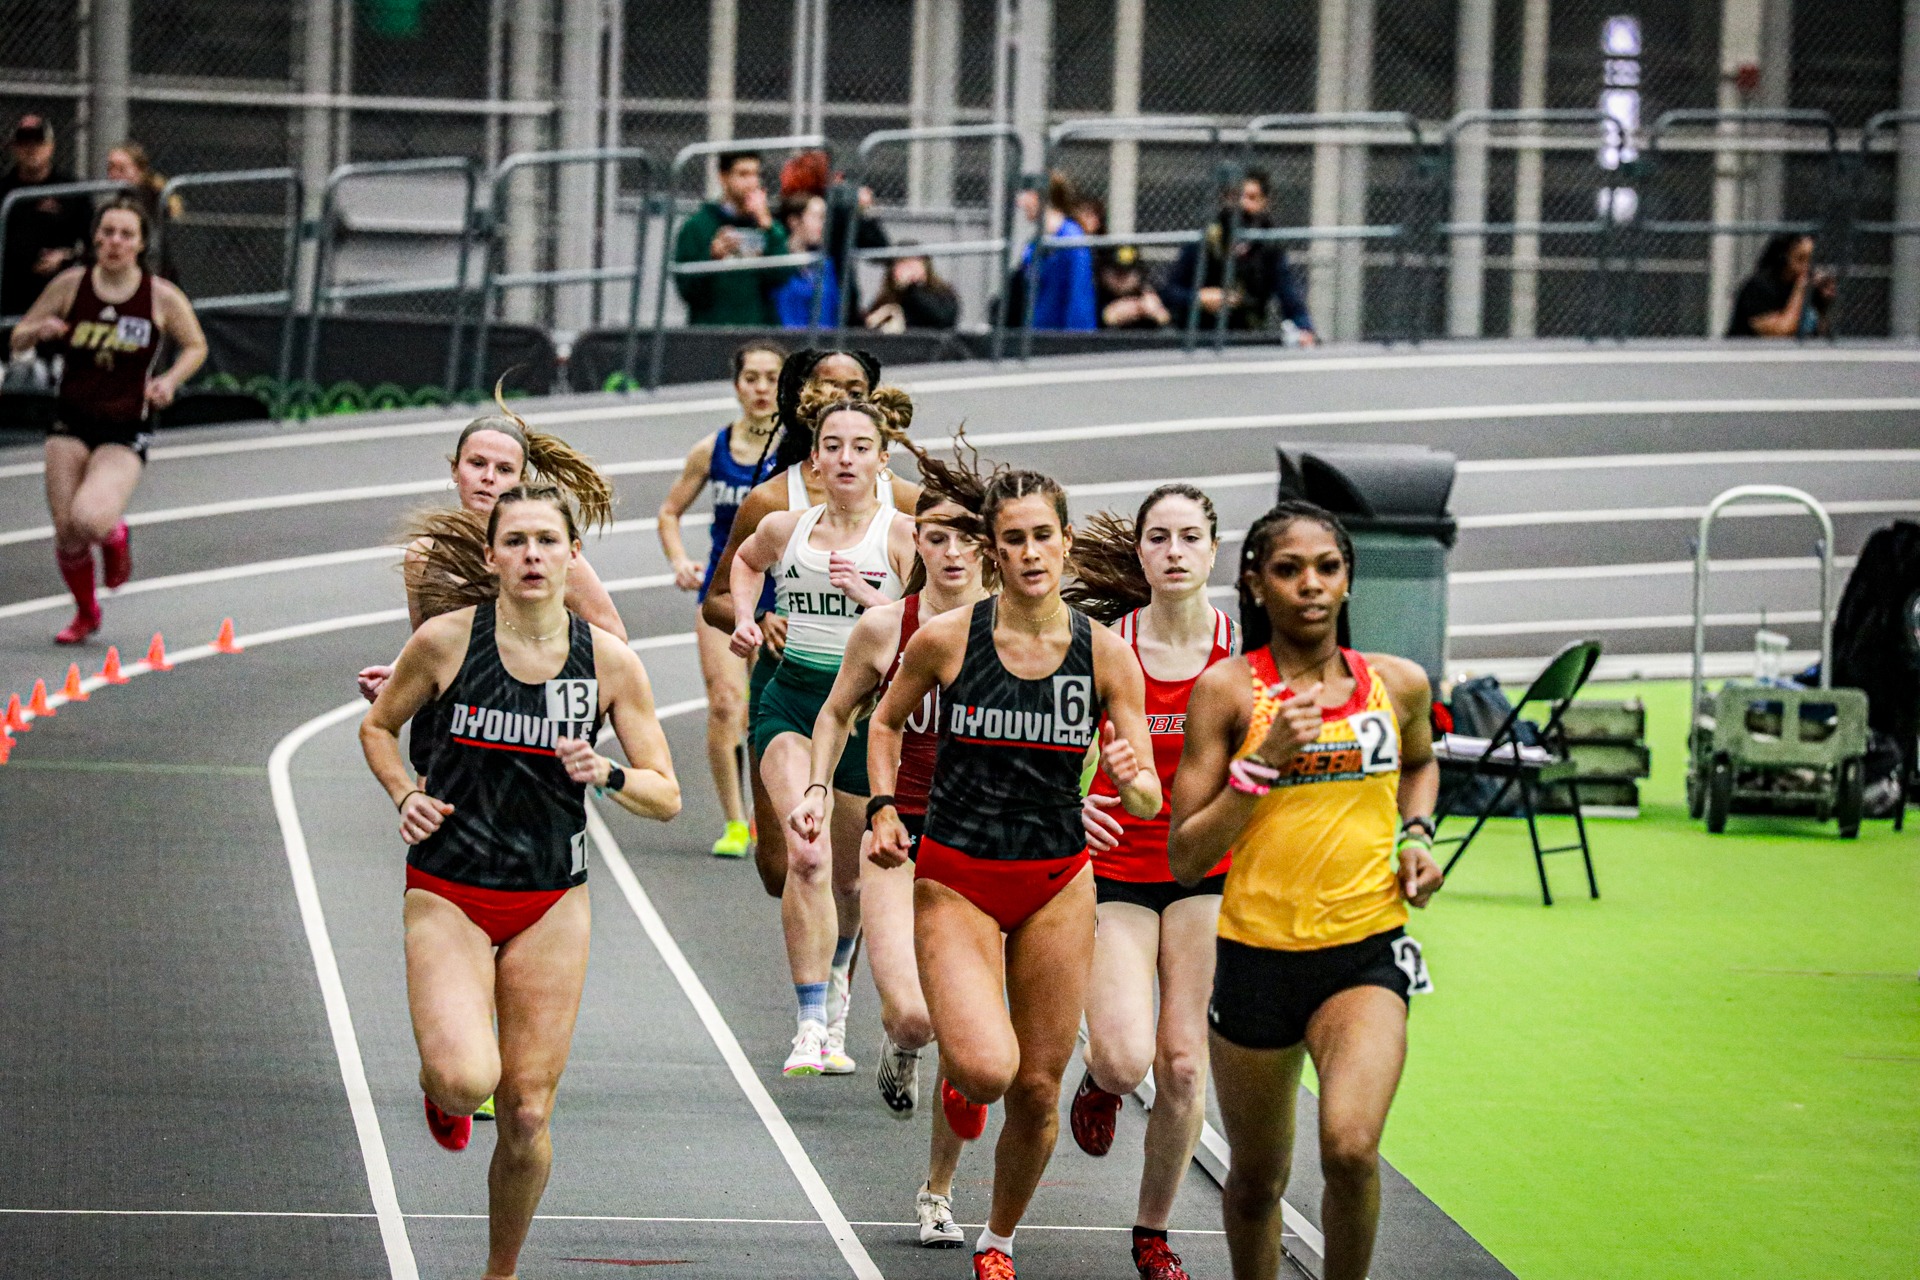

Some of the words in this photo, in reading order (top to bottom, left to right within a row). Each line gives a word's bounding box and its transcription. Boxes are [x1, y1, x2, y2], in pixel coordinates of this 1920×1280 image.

[788, 592, 854, 617] FELICI
[556, 682, 590, 719] 13
[1060, 680, 1085, 726] 6
[1360, 717, 1393, 765] 2
[1400, 942, 1427, 989] 2
